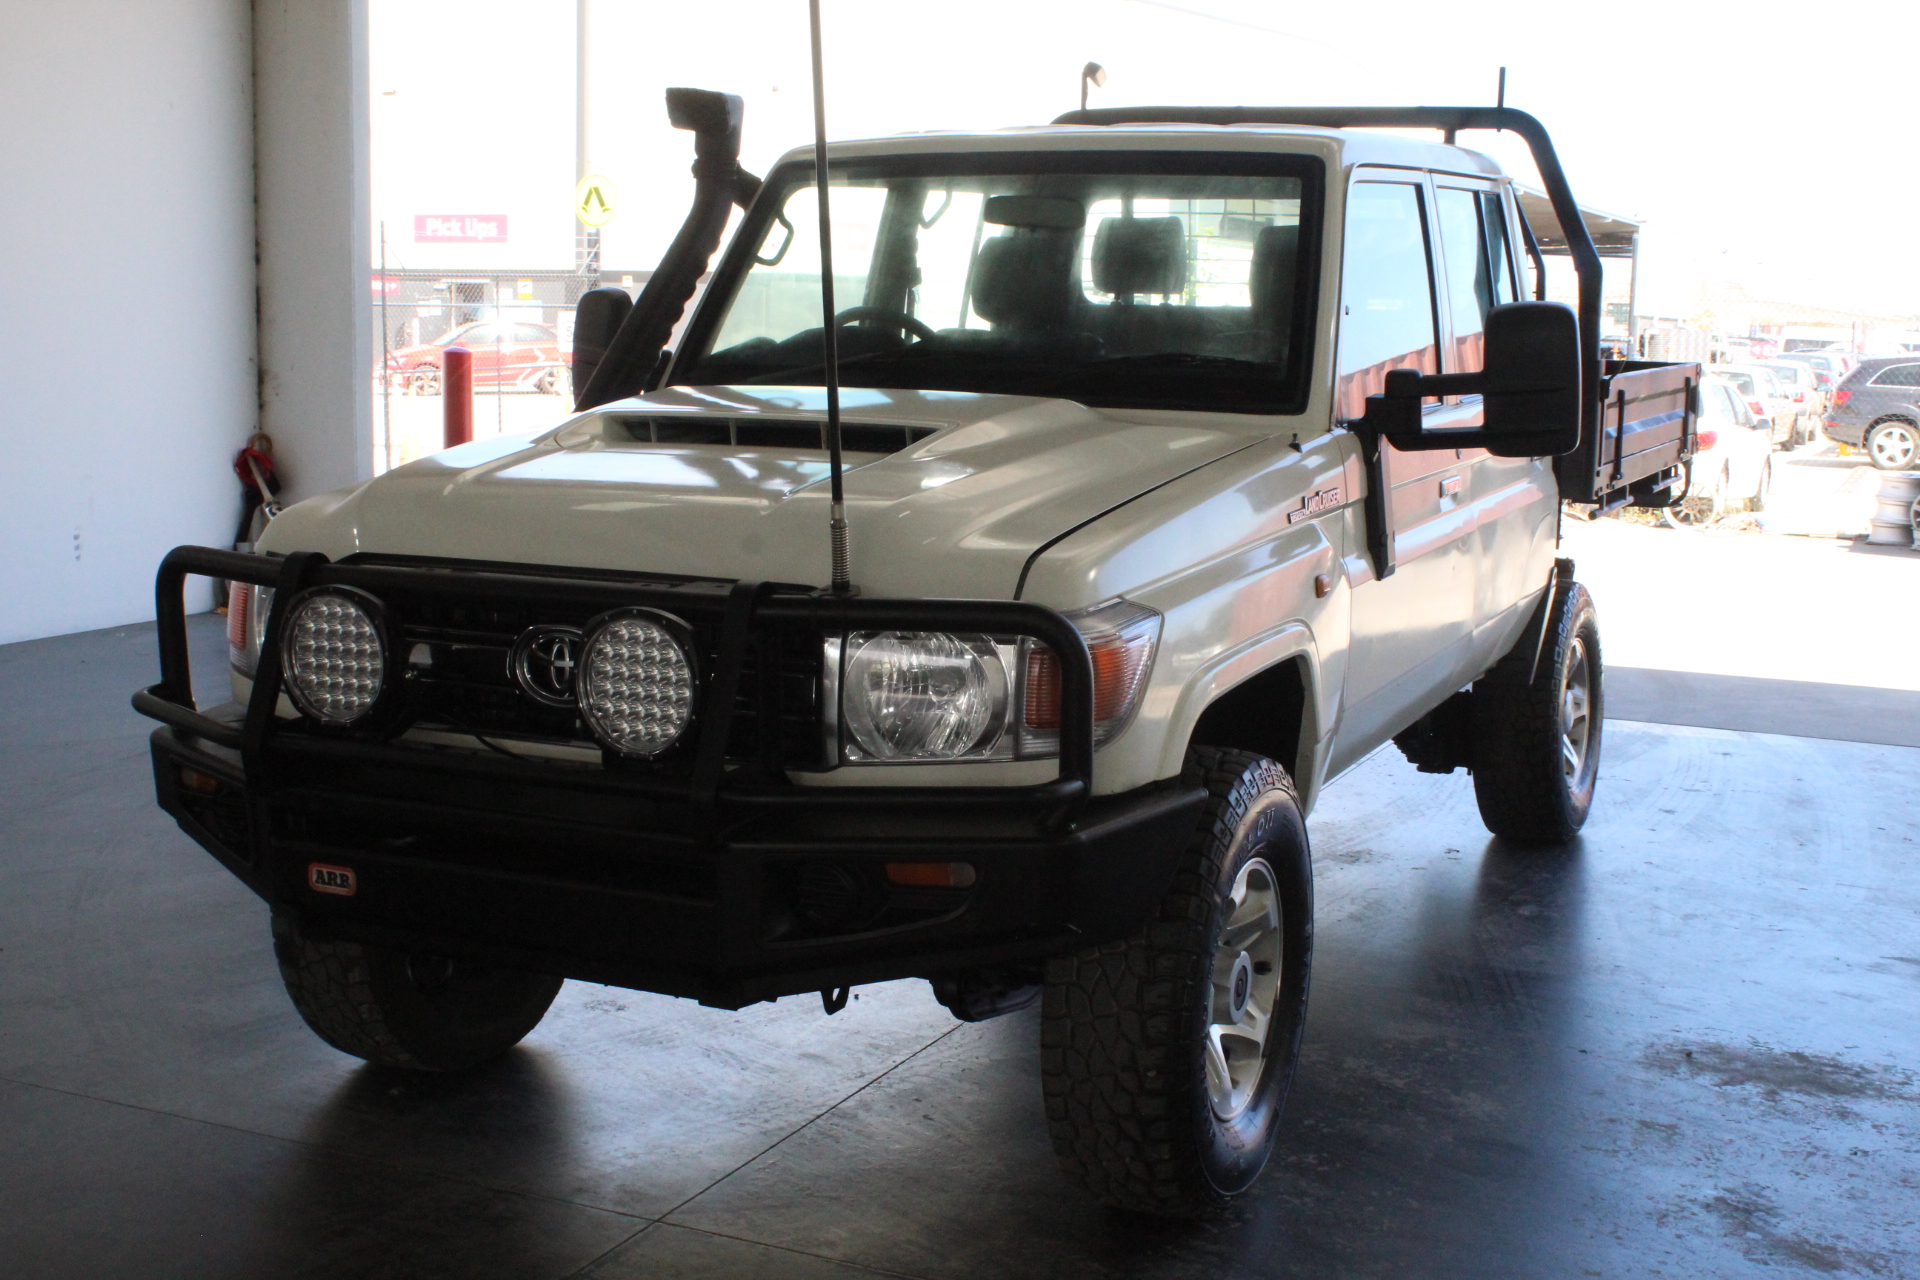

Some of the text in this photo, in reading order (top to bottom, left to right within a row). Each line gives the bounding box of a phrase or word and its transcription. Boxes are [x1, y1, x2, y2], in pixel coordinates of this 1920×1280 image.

[426, 218, 498, 240] Pick Ups
[314, 868, 351, 889] ARB
